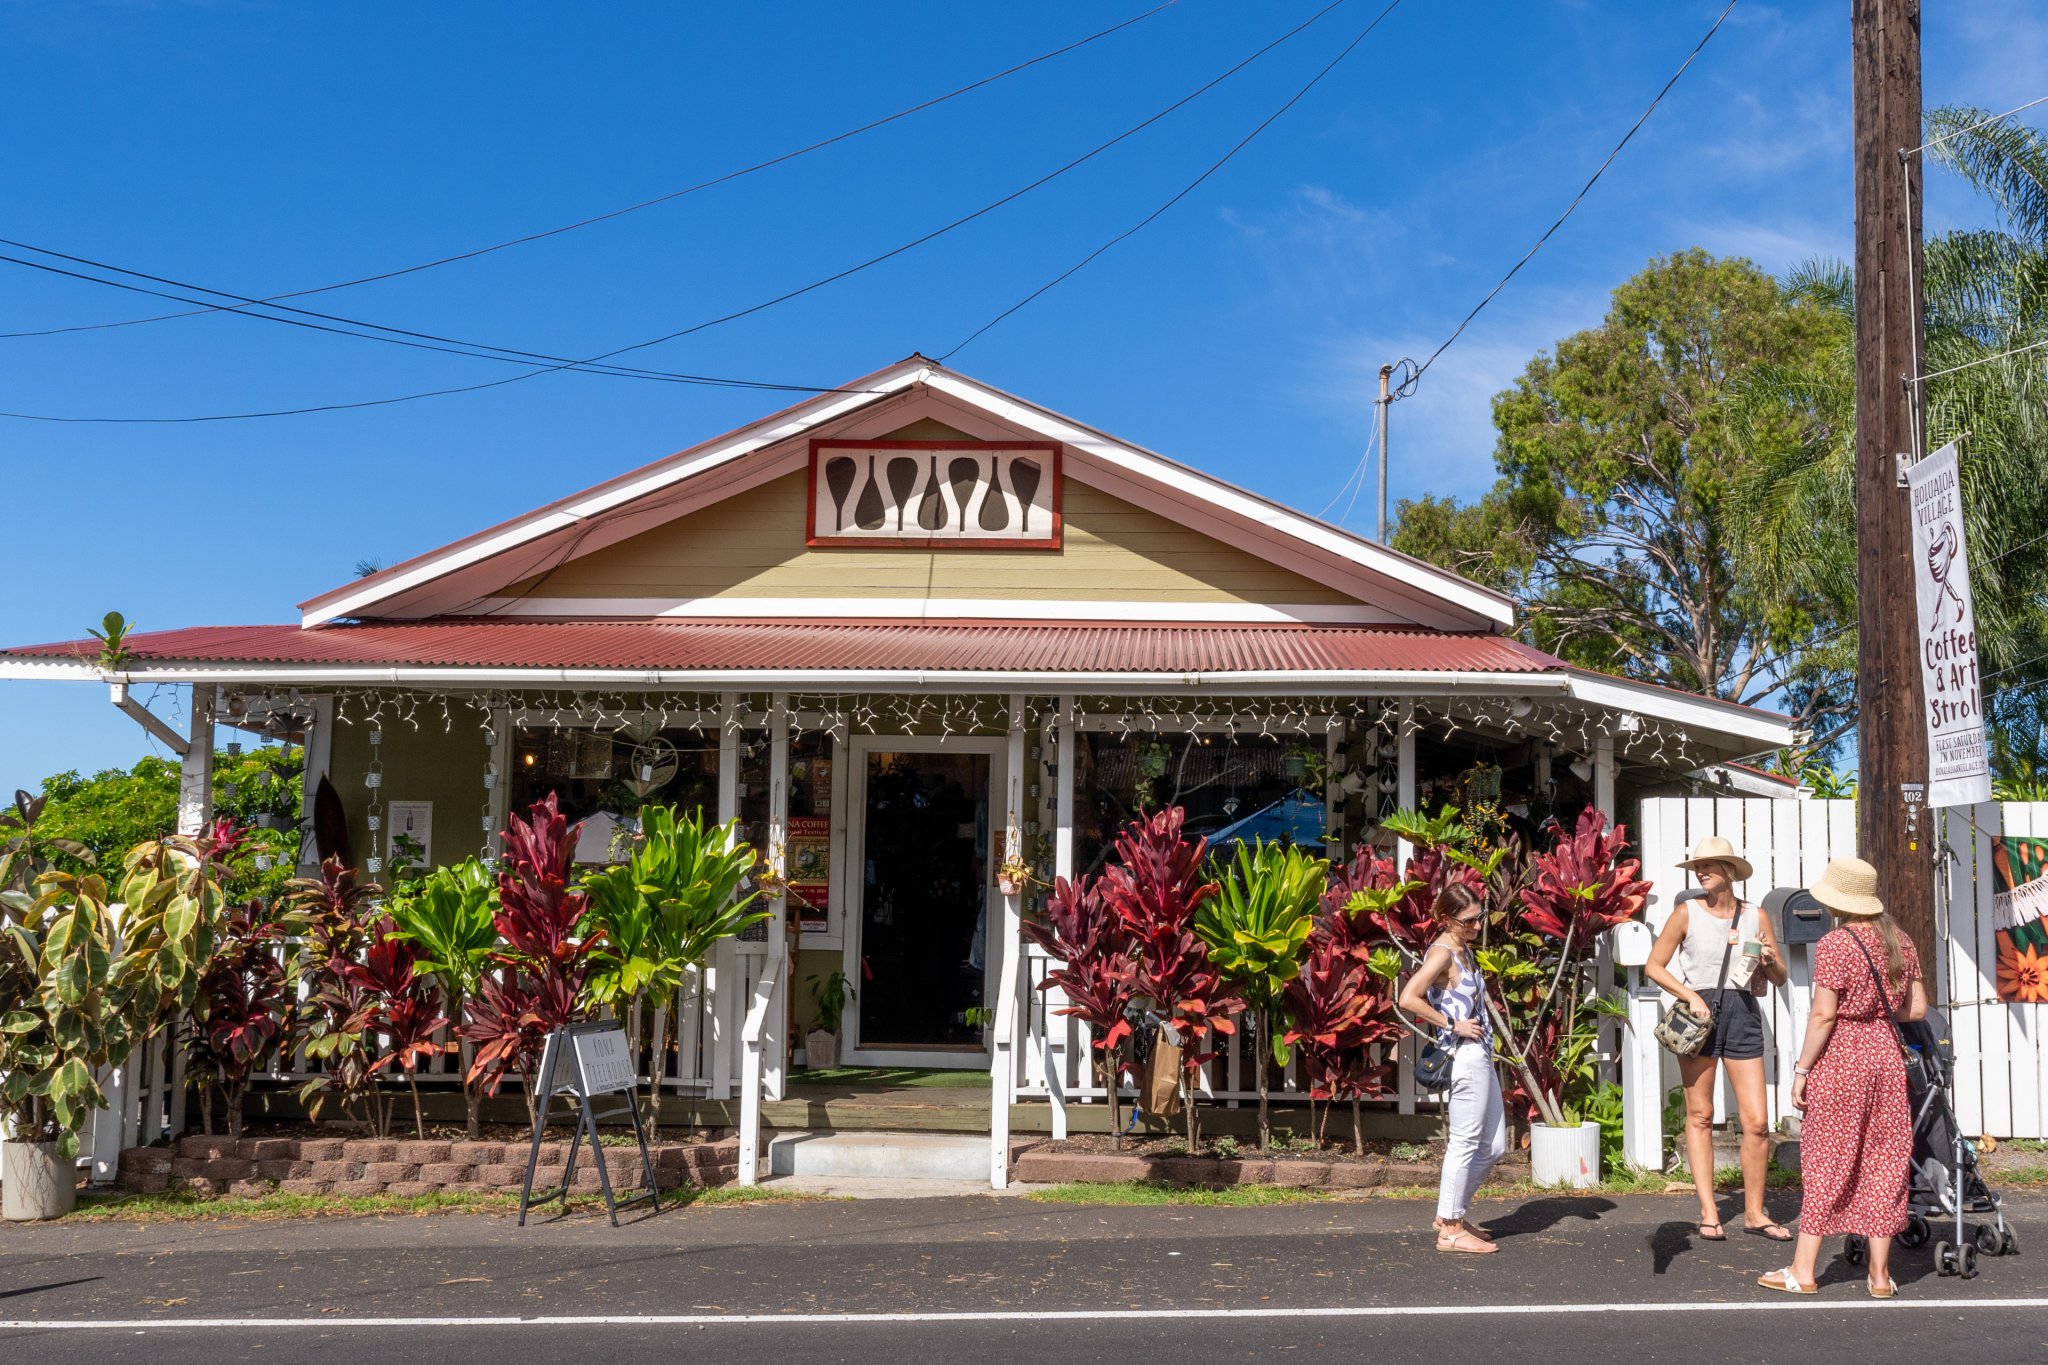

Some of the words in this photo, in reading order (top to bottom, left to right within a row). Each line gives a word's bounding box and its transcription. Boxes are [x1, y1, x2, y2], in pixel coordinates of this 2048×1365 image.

[1914, 469, 1955, 507] HOLUALOA
[1918, 492, 1954, 526] VILLAGE
[1926, 629, 1976, 670] Coffee
[1936, 666, 1946, 692] &
[1951, 658, 1976, 691] Art
[1929, 688, 1982, 729] Stroll
[1940, 751, 1948, 763] IN
[1903, 791, 1923, 803] 102
[801, 820, 829, 828] COFFEE
[593, 1037, 616, 1058] KONA
